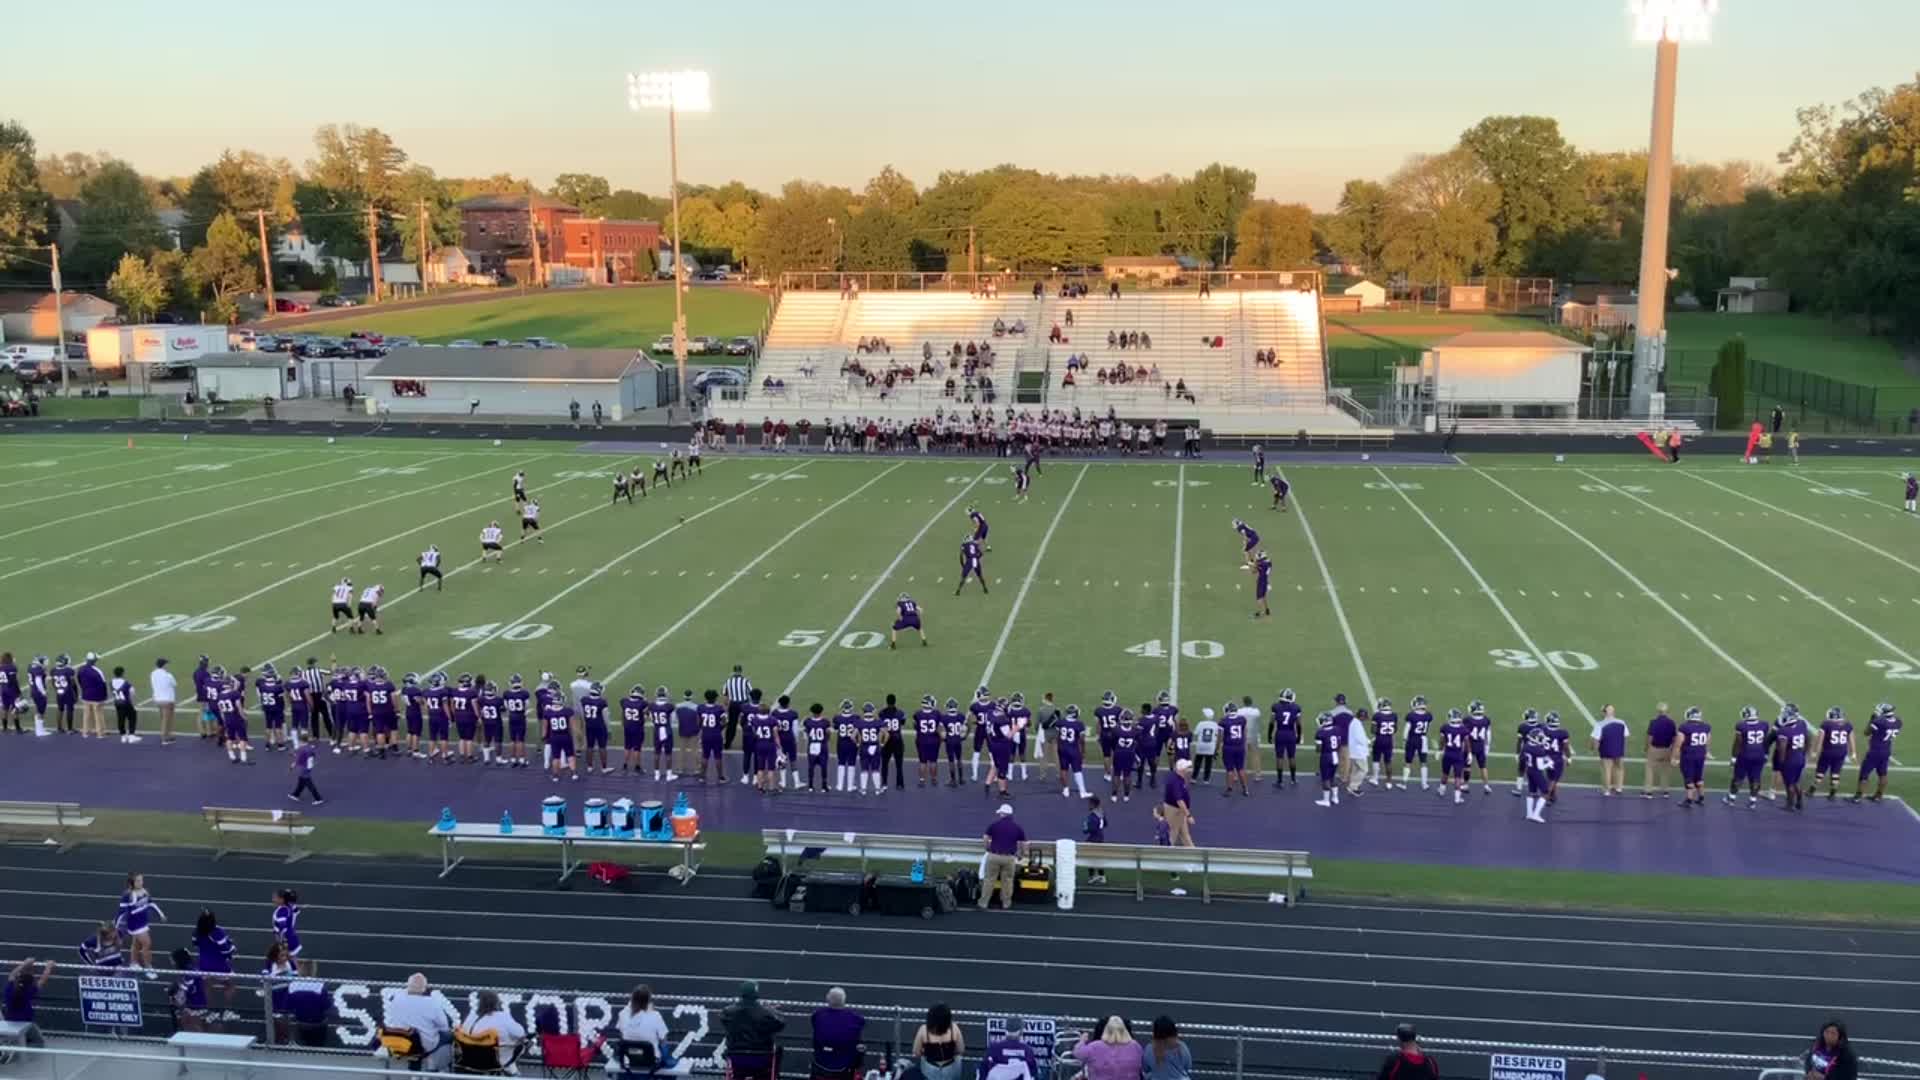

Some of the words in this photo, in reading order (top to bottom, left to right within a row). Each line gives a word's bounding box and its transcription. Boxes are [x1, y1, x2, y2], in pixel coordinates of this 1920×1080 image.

[129, 613, 237, 633] 30
[449, 622, 554, 641] 40
[777, 629, 886, 649] 50
[1123, 639, 1226, 659] 40
[1488, 649, 1599, 671] 30
[372, 690, 388, 704] 65
[482, 705, 498, 720] 63
[1282, 711, 1290, 726] 7
[550, 715, 568, 730] 90
[701, 713, 717, 728] 78
[919, 719, 938, 734] 53
[1102, 715, 1117, 729] 15
[1380, 721, 1395, 735] 25
[755, 725, 772, 740] 43
[809, 727, 825, 741] 40
[1691, 732, 1708, 747] 50
[1830, 730, 1848, 745] 56
[1447, 733, 1461, 748] 14
[80, 979, 136, 989] RESERVED
[1494, 1056, 1562, 1069] RESERVED
